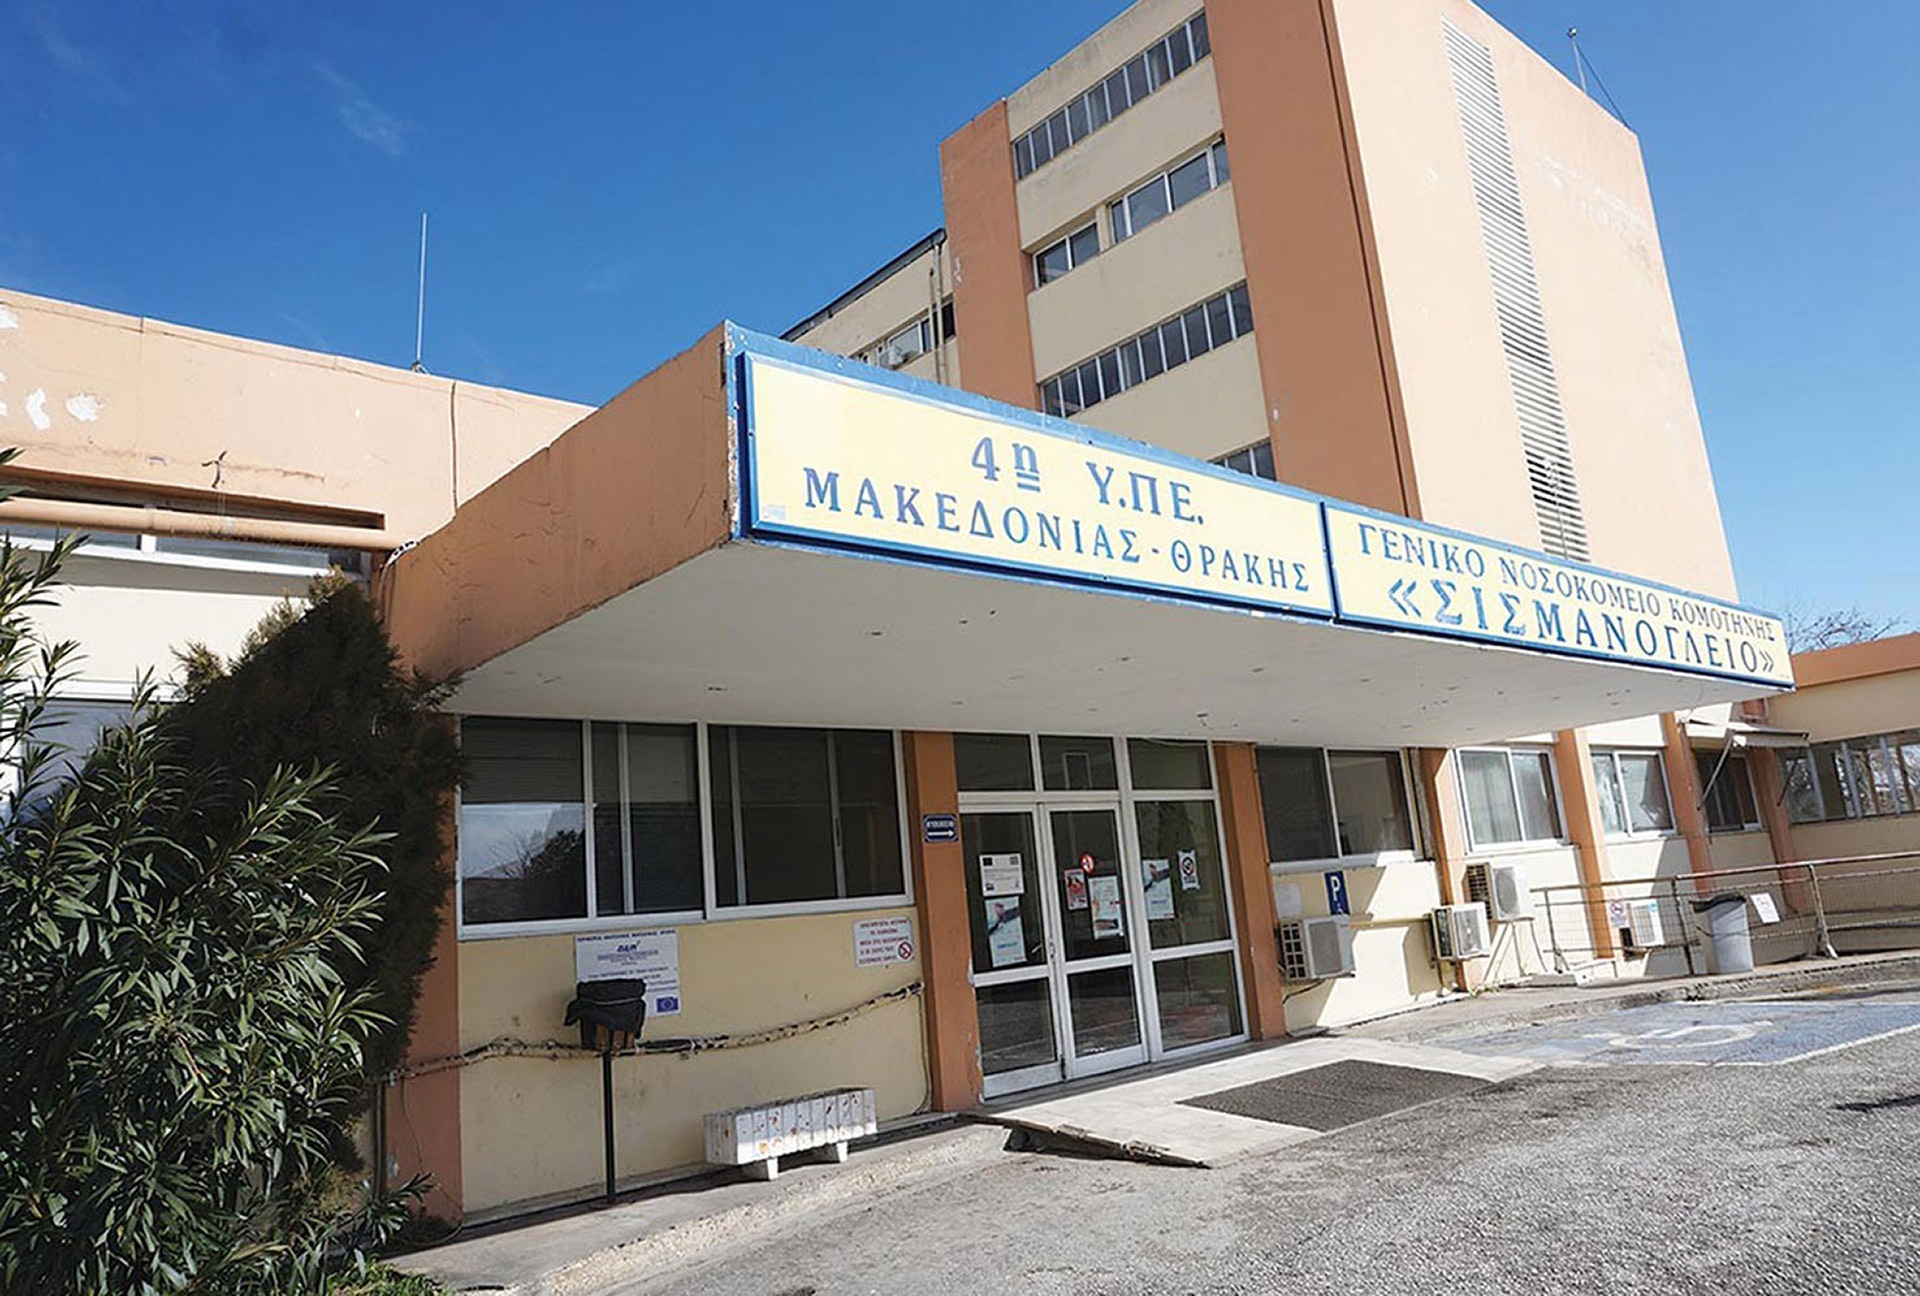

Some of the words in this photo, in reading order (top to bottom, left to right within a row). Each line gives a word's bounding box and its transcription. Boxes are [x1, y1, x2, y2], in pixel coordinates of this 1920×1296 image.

[804, 467, 1140, 564] ΜΑΚΕΔΟΝΙΑΣ
[1170, 540, 1310, 593] ΘΡΑΚΗΣ
[1086, 460, 1205, 525] Υ.ΠΕ.
[1358, 523, 1486, 578] ΓΕΝΙΚΟ
[1498, 556, 1661, 617] ΝΟΣΟΚΟΜΕΙΟ
[1669, 598, 1776, 643] ΚΟΜΟΤΗΝΗΣ
[1388, 578, 1775, 674] «ΣΙΣΜΑΝΟΓΛΕΙΟ»
[1330, 876, 1341, 901] P
